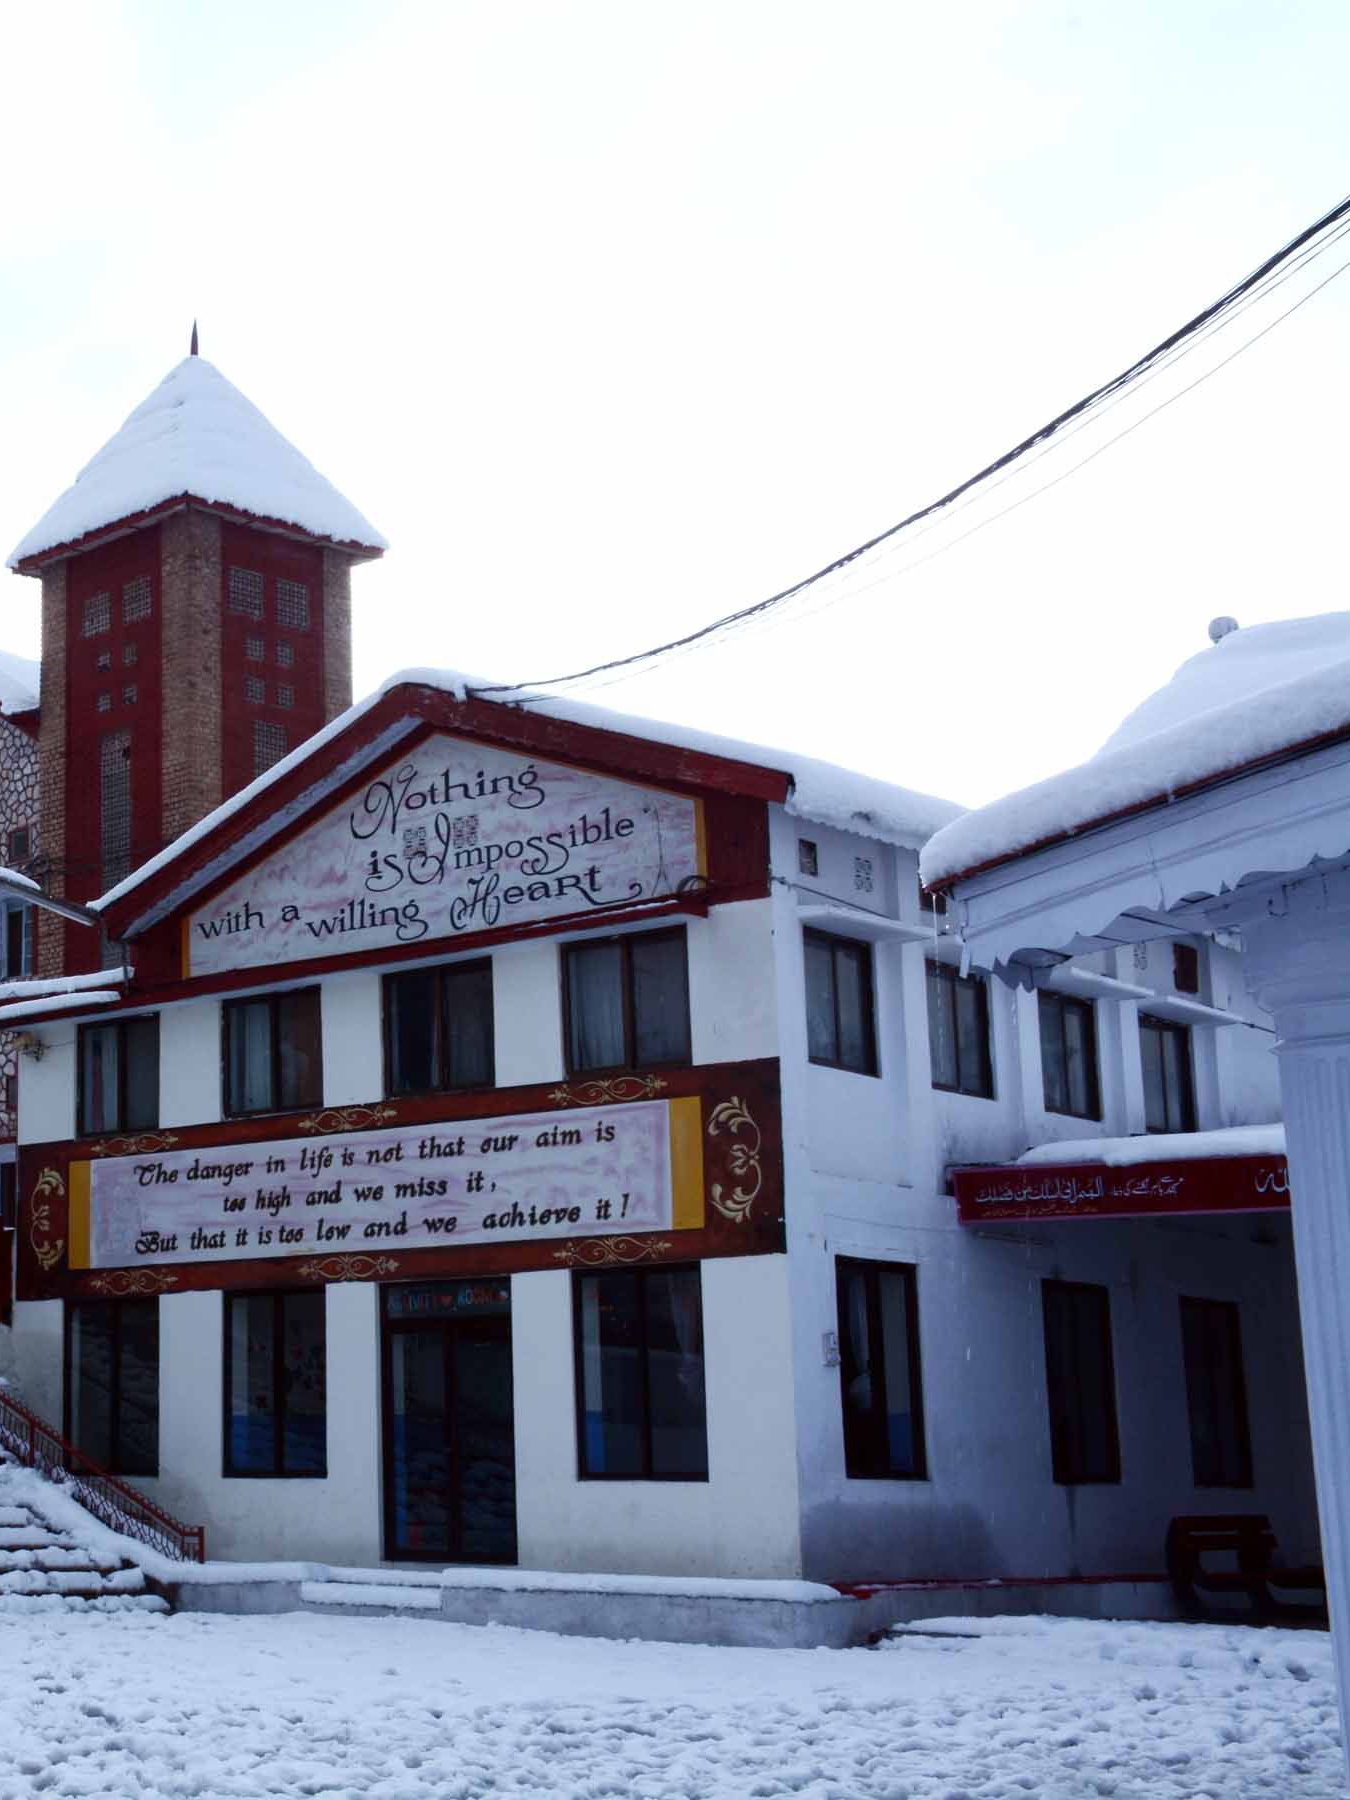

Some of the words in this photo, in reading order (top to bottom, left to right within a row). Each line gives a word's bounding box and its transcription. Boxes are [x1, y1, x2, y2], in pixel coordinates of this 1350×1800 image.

[351, 764, 545, 839] Nothing
[365, 850, 404, 892] is
[408, 806, 635, 885] Impossible
[198, 902, 265, 939] with
[281, 904, 300, 923] a
[306, 898, 428, 941] willing
[133, 1163, 179, 1187] The
[186, 1159, 253, 1186] danger
[265, 1155, 286, 1174] in
[299, 1148, 334, 1178] life
[341, 1147, 354, 1167] is
[366, 1143, 404, 1164] not
[418, 1136, 465, 1159] that
[480, 1133, 519, 1154] our
[535, 1126, 582, 1147] aim
[596, 1121, 616, 1143] is
[223, 1195, 247, 1212] too
[255, 1186, 291, 1216] high
[305, 1180, 343, 1206] and
[353, 1186, 384, 1203] we
[394, 1175, 448, 1199] miss
[466, 1171, 497, 1193] it,
[134, 1231, 178, 1255] But
[190, 1227, 226, 1251] that
[236, 1228, 248, 1247] it
[258, 1225, 271, 1246] is
[278, 1224, 303, 1244] too
[317, 1218, 351, 1242] low
[363, 1211, 408, 1239] and
[422, 1216, 457, 1233] we
[482, 1201, 581, 1230] achieve
